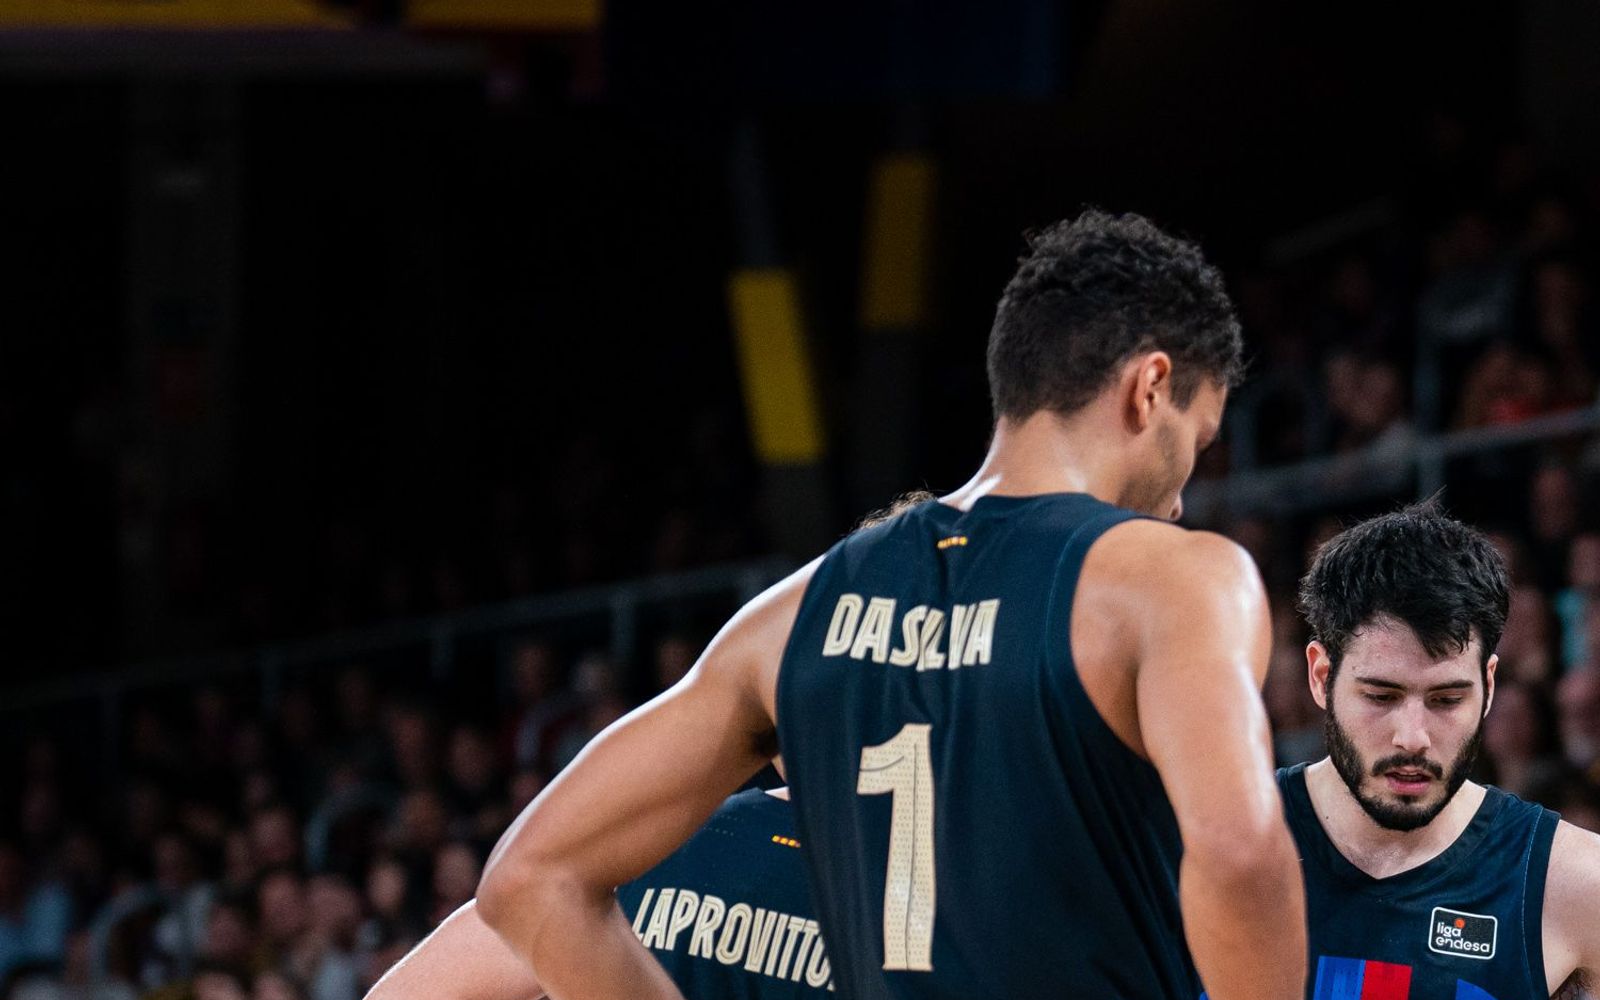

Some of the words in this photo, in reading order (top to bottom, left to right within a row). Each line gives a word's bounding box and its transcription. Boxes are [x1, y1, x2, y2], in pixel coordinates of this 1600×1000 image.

[857, 723, 937, 972] 1
[631, 887, 836, 993] LAPROVITTO
[1435, 936, 1490, 952] endesa
[1437, 922, 1462, 938] liga
